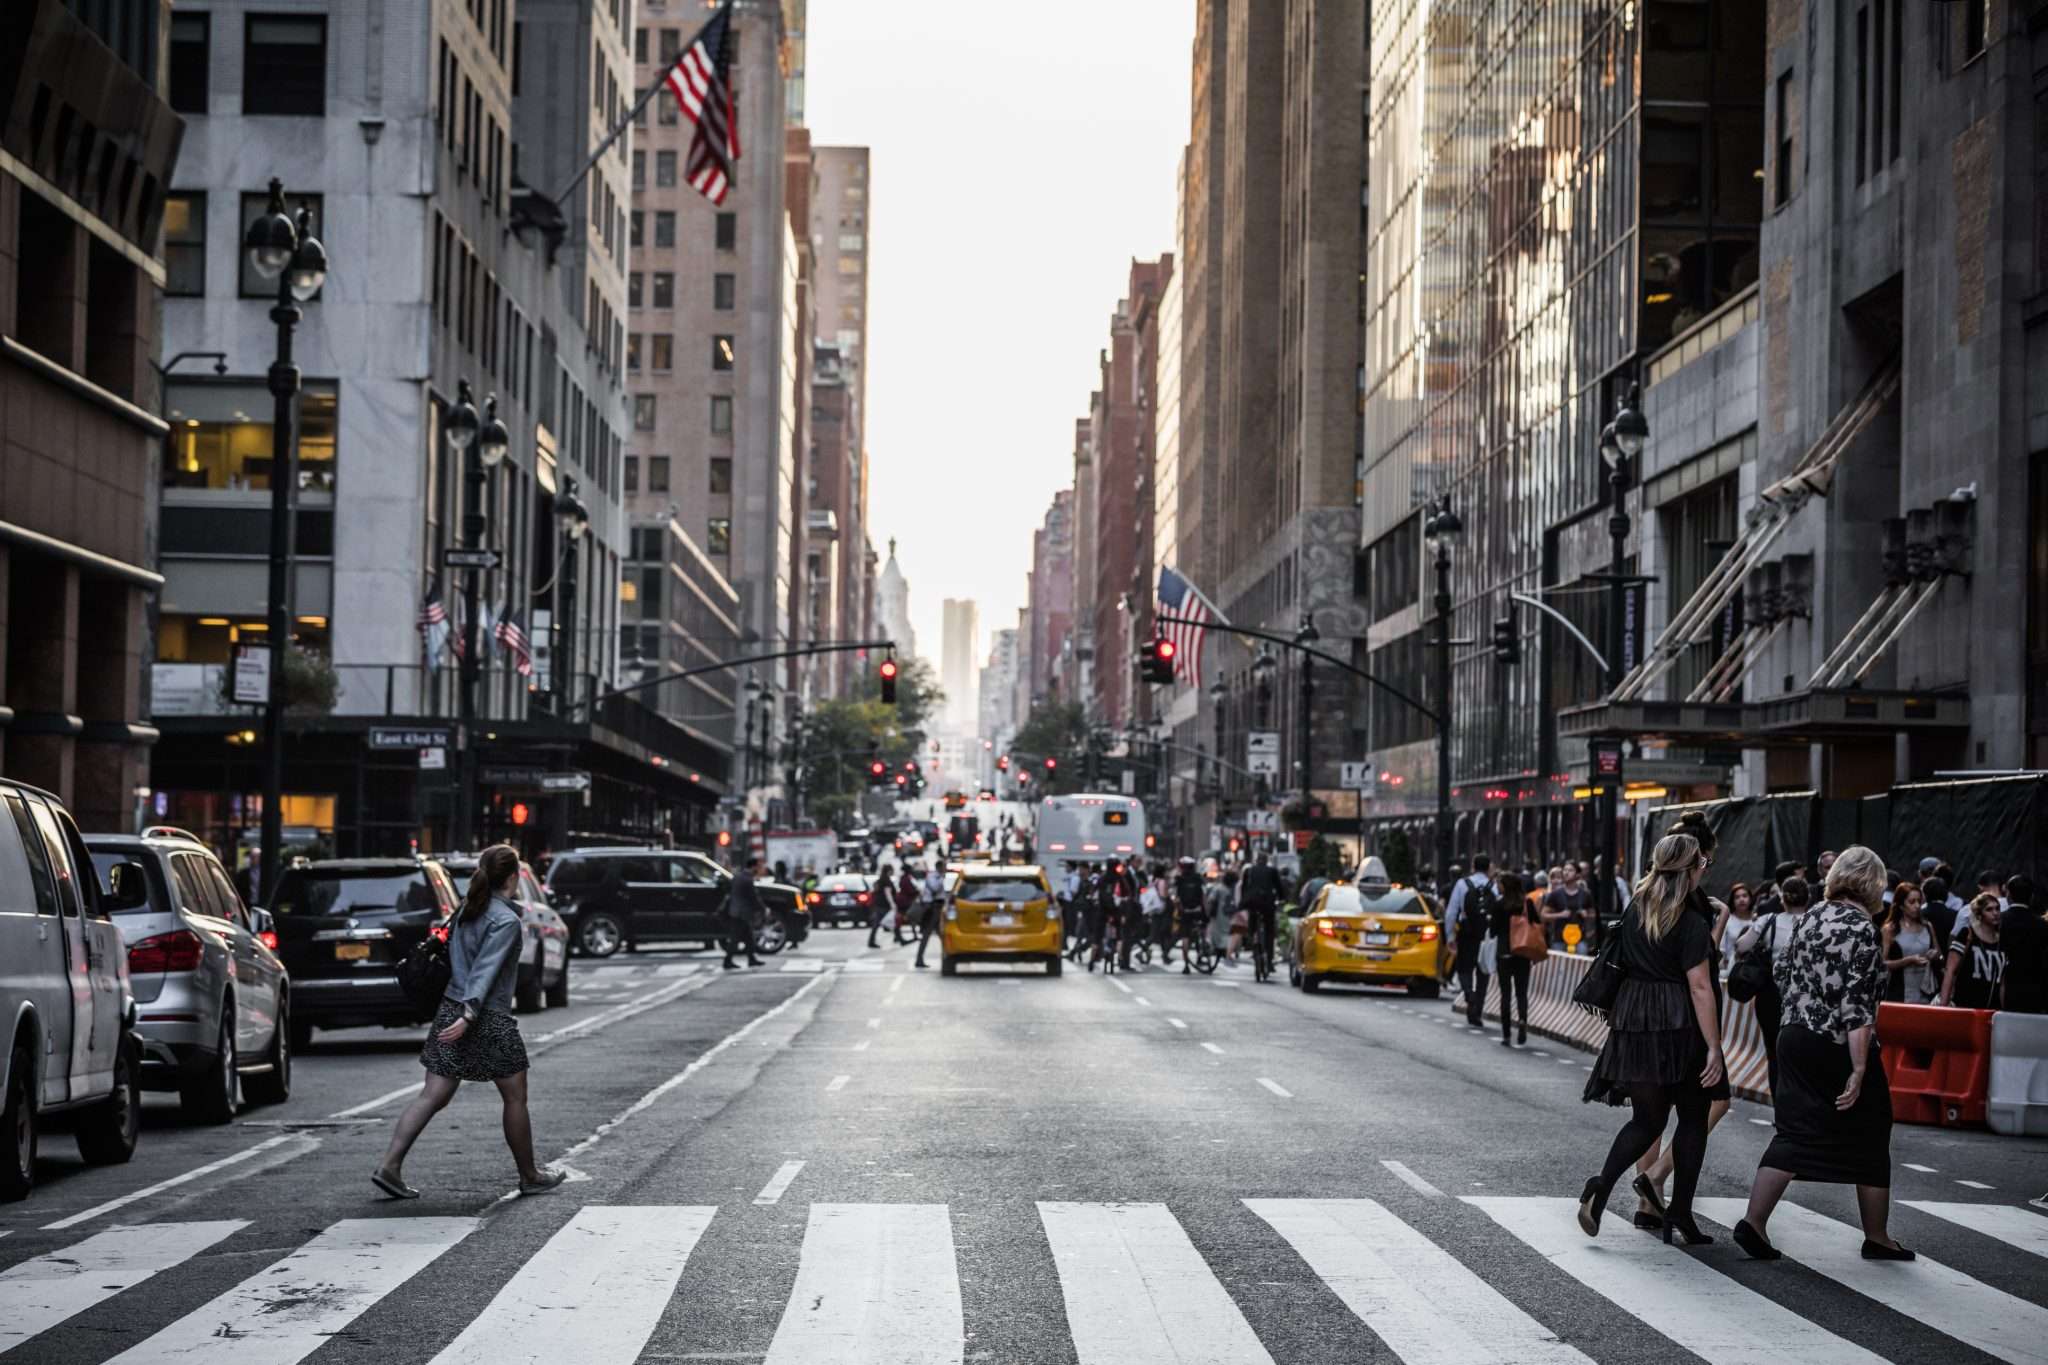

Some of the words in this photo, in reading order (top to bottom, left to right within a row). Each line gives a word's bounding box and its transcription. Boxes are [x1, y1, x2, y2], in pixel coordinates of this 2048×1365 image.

[375, 732, 401, 744] East
[404, 732, 432, 746] 43rd
[433, 733, 447, 746] St
